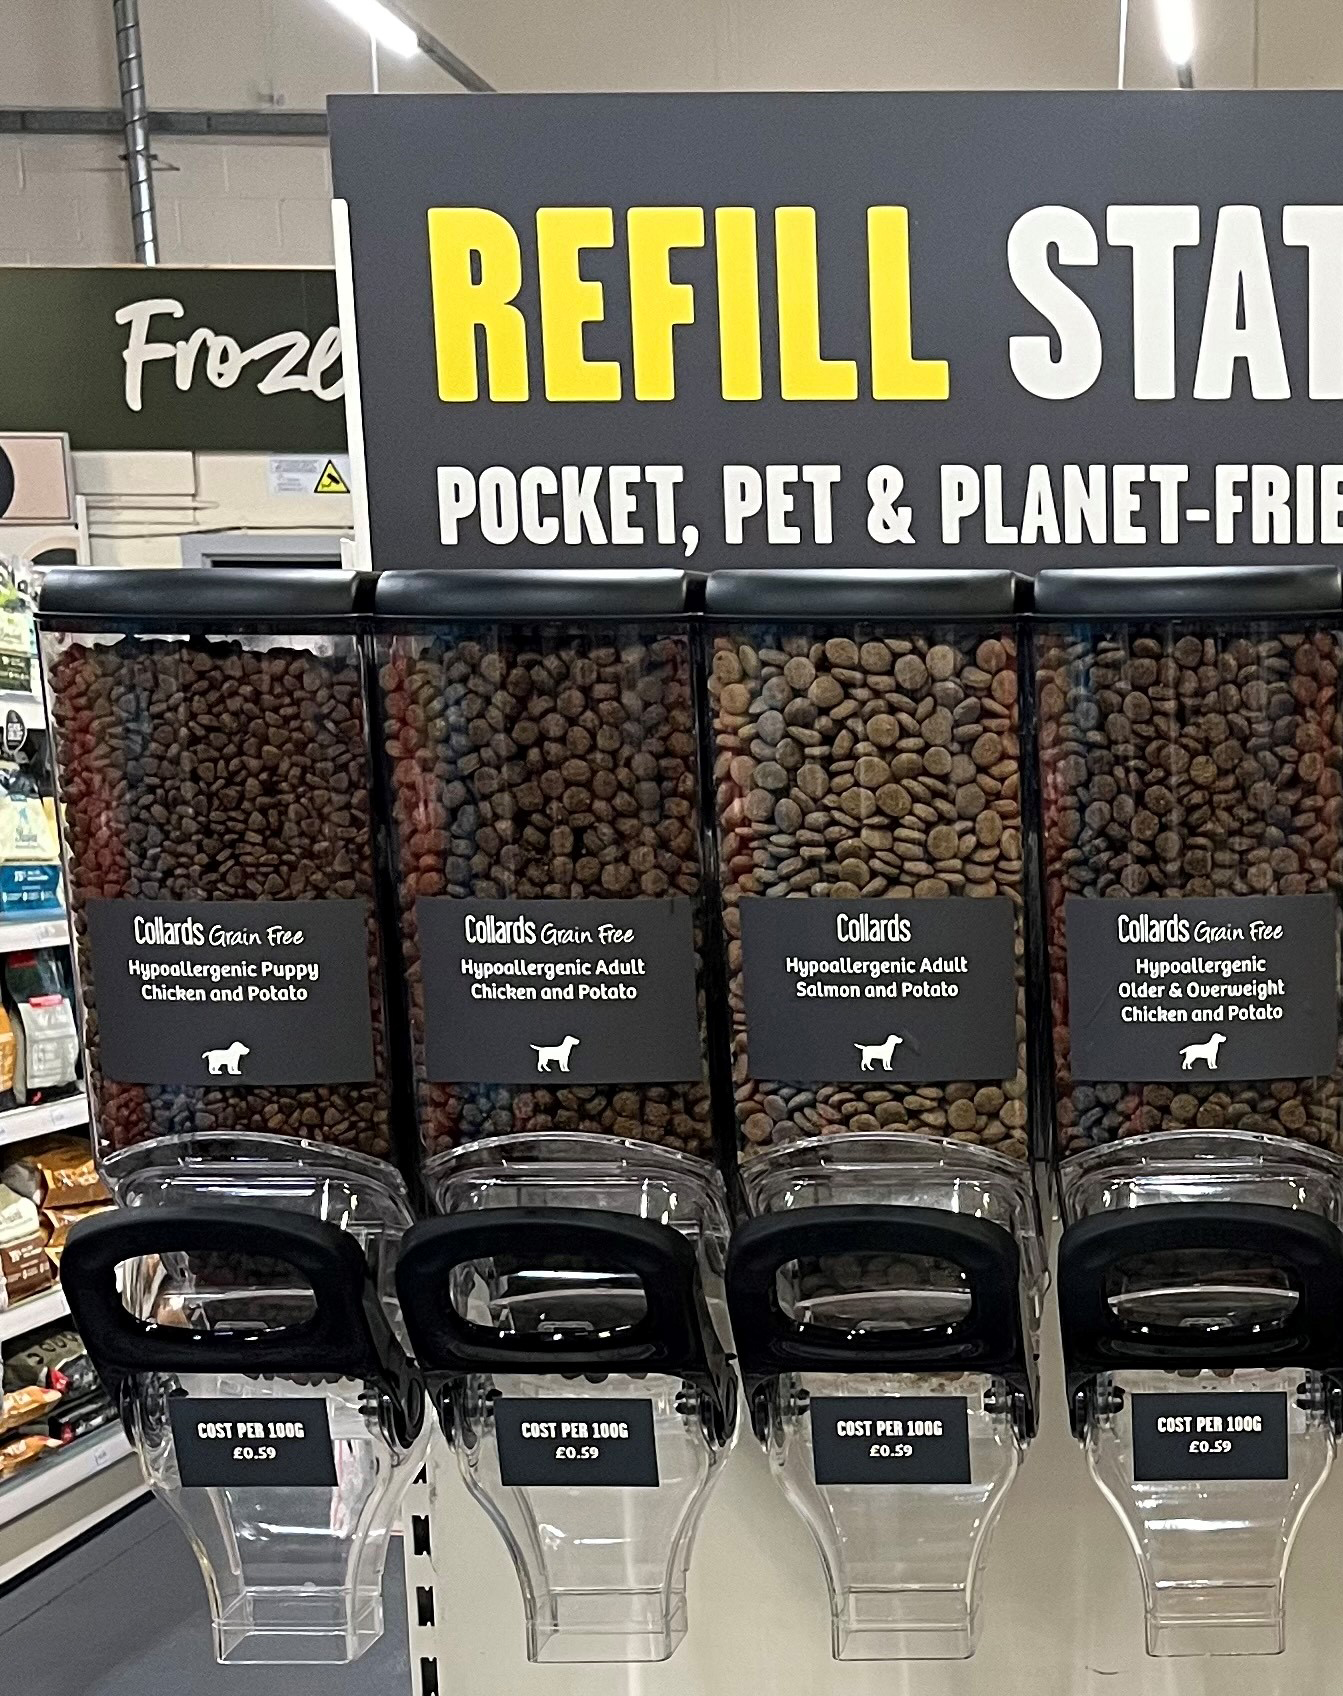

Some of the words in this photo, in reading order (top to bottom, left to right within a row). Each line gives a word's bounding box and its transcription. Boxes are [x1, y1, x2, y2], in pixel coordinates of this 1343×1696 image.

[428, 206, 949, 402] REFILL
[115, 298, 345, 411] Froze
[437, 466, 698, 557] POCKET,
[723, 465, 840, 544] PET
[868, 465, 915, 543] &
[133, 915, 205, 946] Collards
[208, 924, 262, 948] Grain
[266, 925, 305, 947] Free
[464, 914, 537, 945] Collards
[540, 922, 594, 946] Grain
[597, 923, 635, 945] Free
[836, 912, 912, 943] Collards
[1117, 913, 1190, 943] Collards
[1193, 920, 1245, 944] Grain
[1249, 920, 1284, 942] Free
[128, 959, 258, 983] Hypoallergenic
[261, 961, 319, 981] Puppy
[461, 958, 592, 981] Hypoallergenic
[595, 958, 646, 975] Adult
[786, 956, 916, 979] Hypoallergenic
[919, 956, 968, 973] Adult
[1136, 955, 1267, 979] Hypoallergenic
[141, 983, 207, 1001] Chicken
[209, 985, 244, 1002] and
[247, 984, 308, 1002] Potato
[470, 982, 537, 1000] Chicken
[540, 983, 575, 1000] and
[578, 982, 637, 1000] Potato
[796, 981, 861, 998] Salmon
[864, 981, 898, 998] and
[901, 980, 959, 998] Potato
[1118, 981, 1166, 999] Older
[1168, 982, 1183, 998] &
[1186, 978, 1286, 1002] Overweight
[1121, 1005, 1188, 1022] Chicken
[1191, 1004, 1224, 1022] and
[1228, 1003, 1283, 1021] Potato
[197, 1422, 233, 1439] COST
[236, 1422, 265, 1439] PER
[267, 1422, 305, 1439] 100G
[521, 1422, 557, 1439] COST
[561, 1422, 589, 1439] PER
[591, 1422, 629, 1439] 100G
[1157, 1416, 1193, 1433] COST
[1196, 1416, 1223, 1433] PER
[1226, 1415, 1262, 1432] 100G
[233, 1446, 277, 1460] £0.59
[555, 1445, 599, 1459] £0.59
[869, 1443, 913, 1457] £0.59
[1188, 1439, 1232, 1453] £0.59
